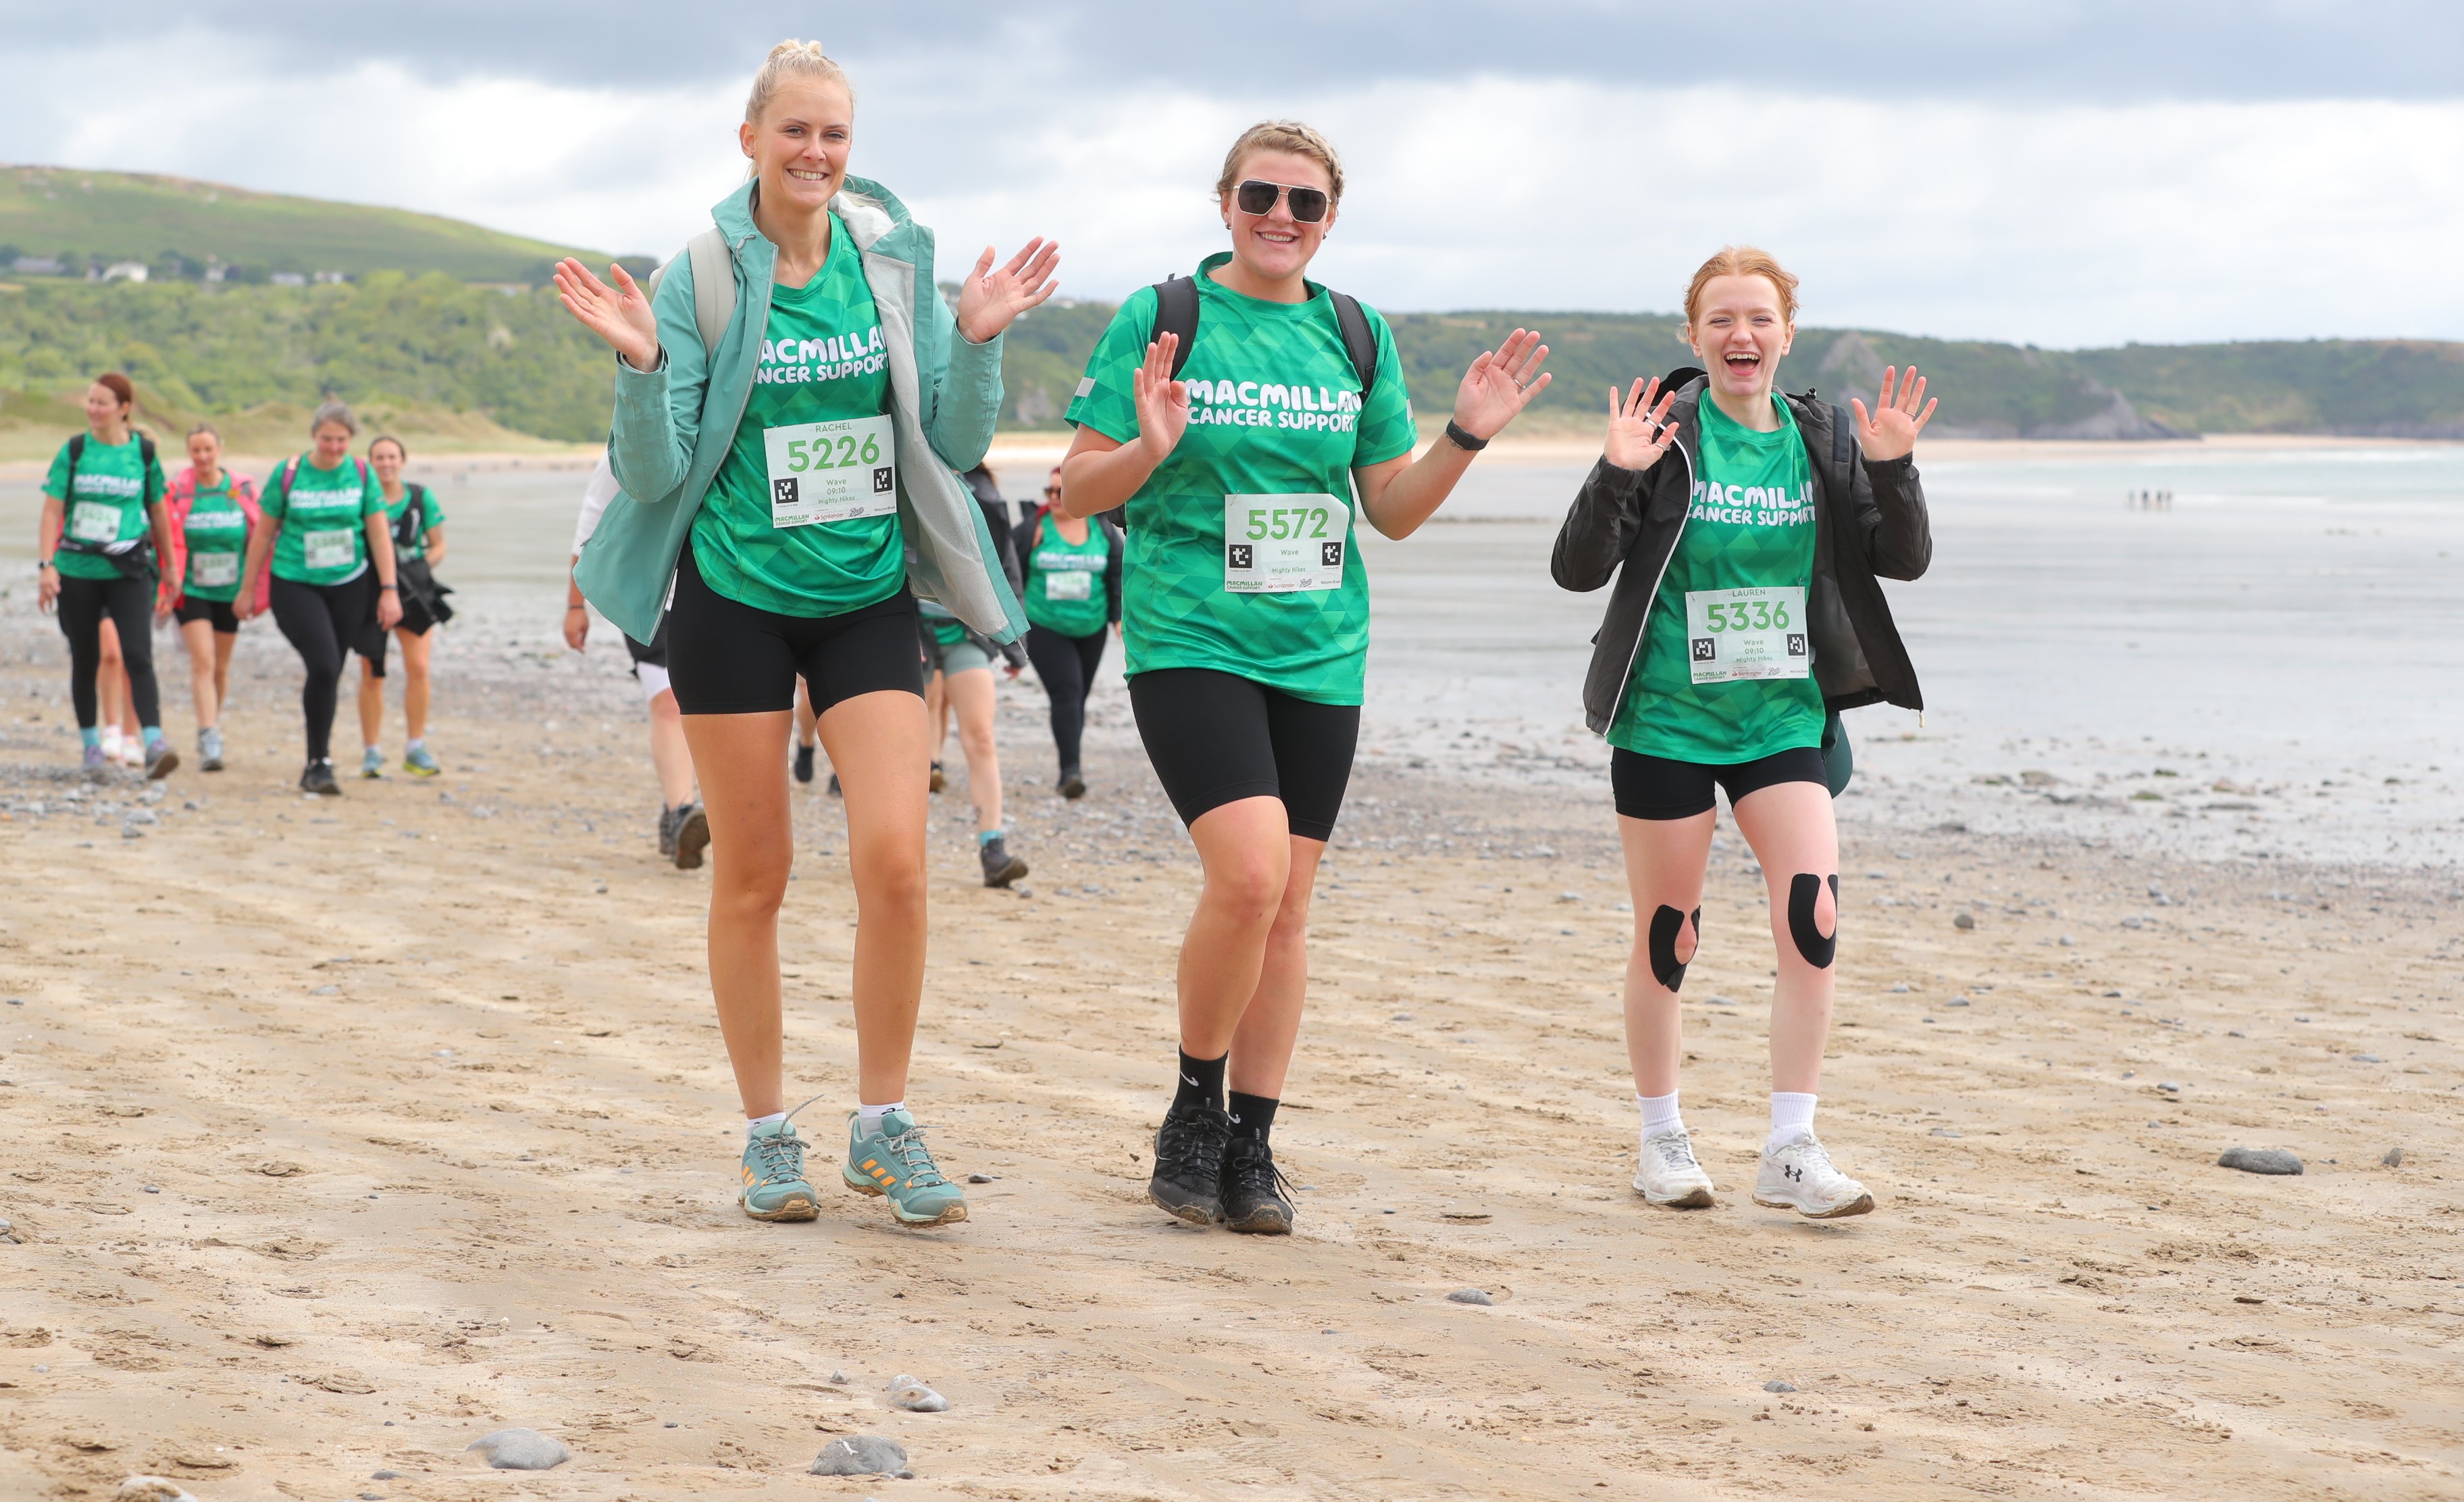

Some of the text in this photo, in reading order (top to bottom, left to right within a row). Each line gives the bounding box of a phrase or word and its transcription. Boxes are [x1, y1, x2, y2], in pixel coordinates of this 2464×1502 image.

[760, 325, 886, 365] ACMILLA
[754, 366, 811, 384] NCER
[1185, 378, 1362, 413] MACMILLAN
[815, 422, 852, 433] RACHEL
[1187, 406, 1356, 432] CANCER SUPPORT
[788, 432, 880, 472] 5226
[826, 478, 847, 486] Wave
[827, 486, 846, 495] 09:10
[818, 497, 838, 505] Mighty
[775, 514, 809, 522] MACMILLAN
[1246, 507, 1329, 541] 5572
[1732, 589, 1766, 597] LAUREN
[1706, 601, 1790, 633] 5336
